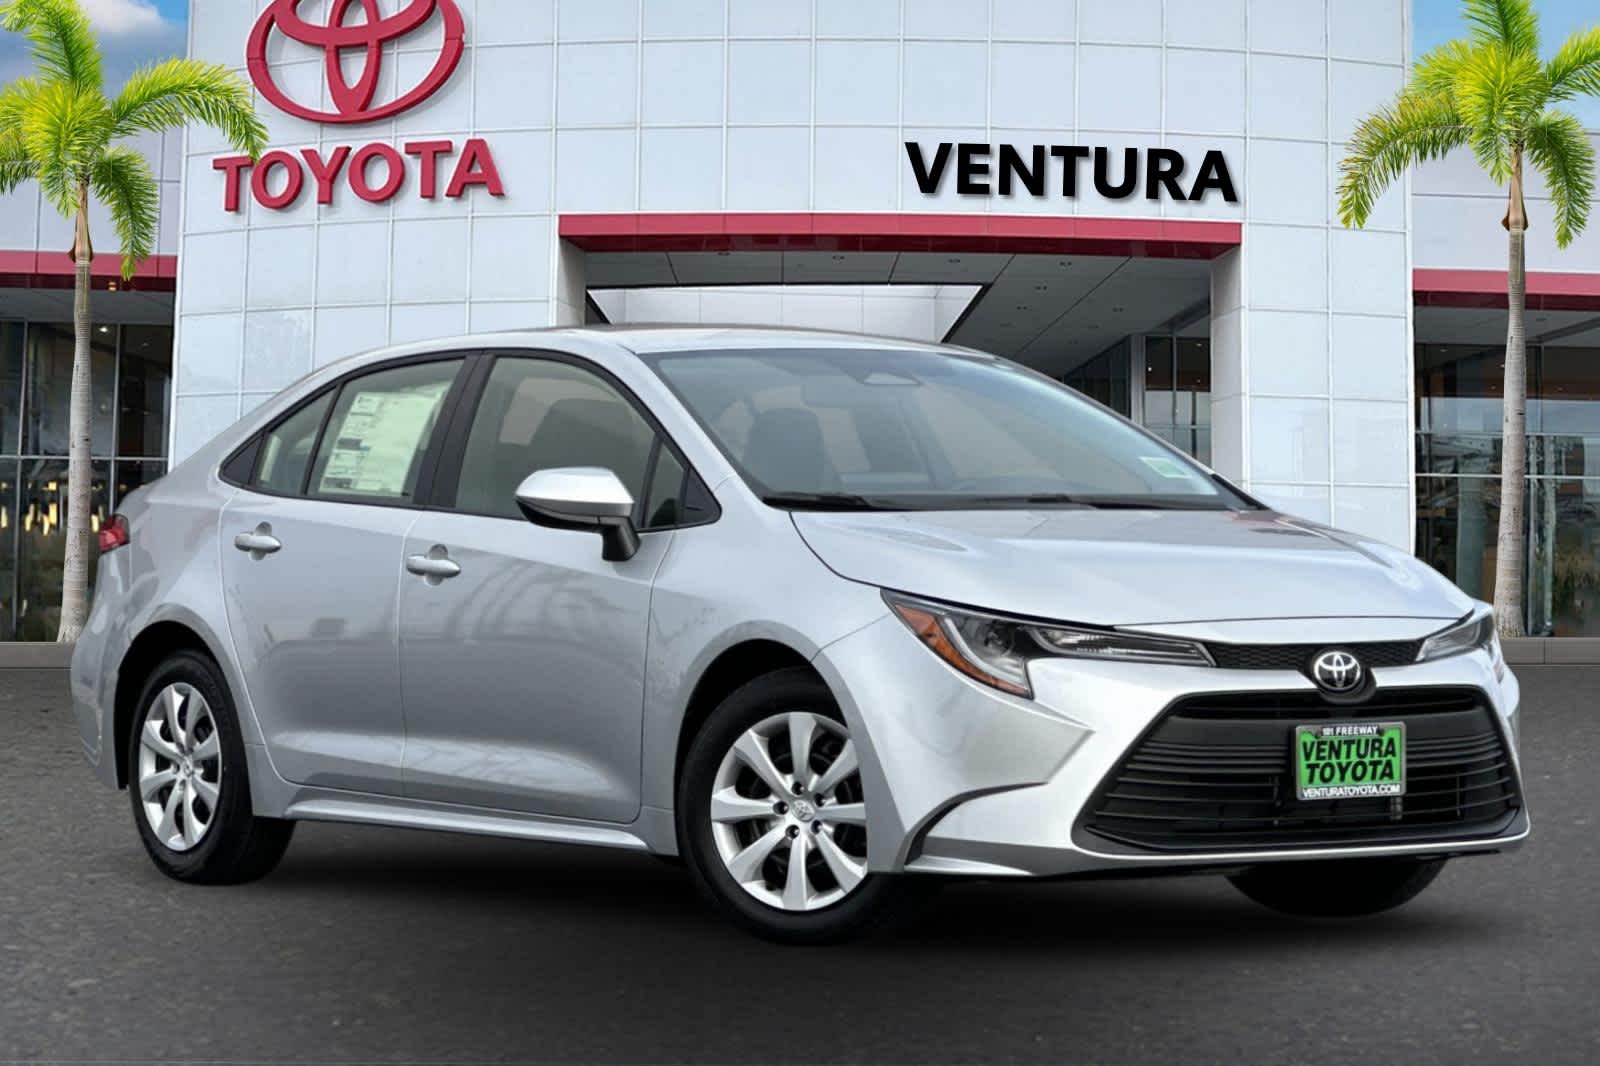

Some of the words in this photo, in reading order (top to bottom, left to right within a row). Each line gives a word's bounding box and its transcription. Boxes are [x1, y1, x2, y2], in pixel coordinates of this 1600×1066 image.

[213, 139, 505, 212] TOYOTA
[905, 142, 1238, 202] VENTURA
[1335, 726, 1378, 735] FREEWAY
[1302, 738, 1397, 761] VENTURA
[1306, 760, 1394, 784] TOYOTA
[1303, 784, 1400, 798] VENTURATOYOTA.COM
